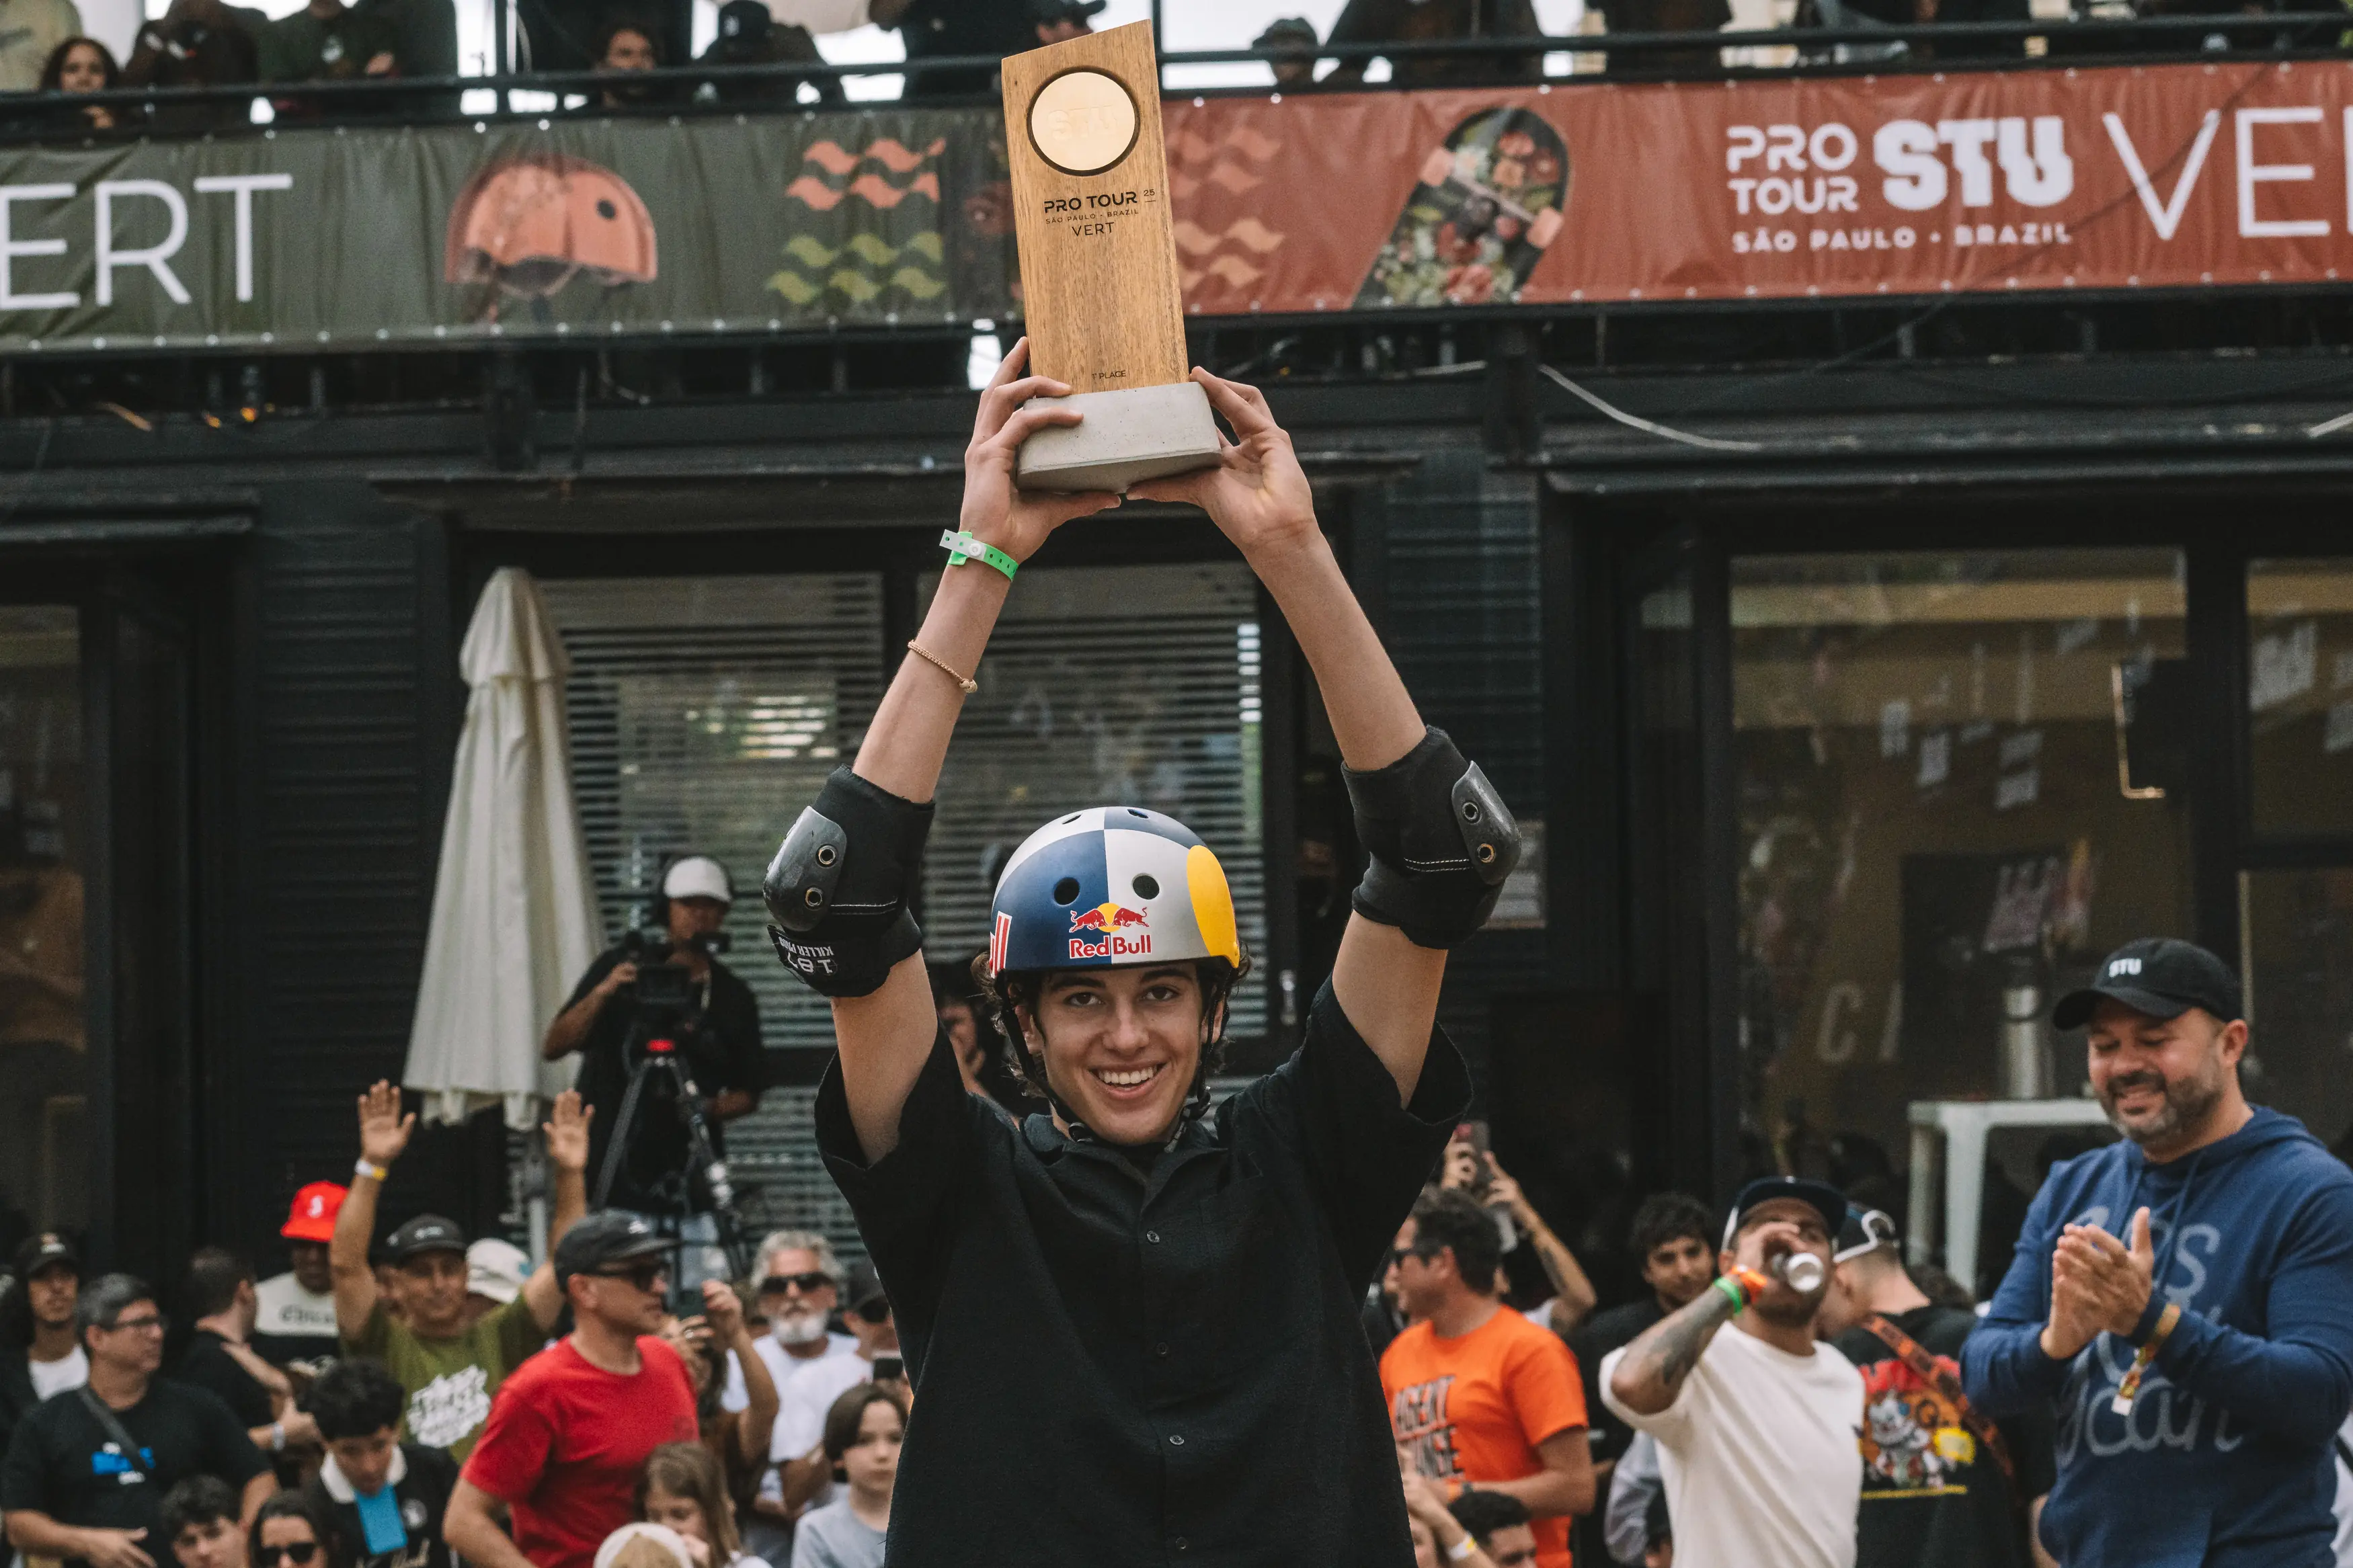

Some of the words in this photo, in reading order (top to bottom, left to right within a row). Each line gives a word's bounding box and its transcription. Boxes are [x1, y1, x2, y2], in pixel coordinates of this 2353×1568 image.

[1726, 123, 1858, 173] PRO
[1873, 116, 2075, 211] STU
[2102, 106, 2353, 241] VE
[1043, 197, 1082, 213] PRO
[1086, 191, 1138, 208] TOUR
[1143, 189, 1155, 197] 25
[1726, 175, 1860, 214] TOUR
[1045, 216, 1063, 224] SÃO
[1067, 213, 1096, 222] PAULO
[1107, 209, 1139, 217] BRAZIL
[1072, 222, 1114, 237] VERT
[1732, 226, 1797, 253] SÃO
[1810, 226, 1916, 252] PAULO
[1954, 222, 2073, 247] BRAZIL
[1099, 370, 1126, 380] PLACE
[797, 945, 834, 957] KILLER
[1070, 936, 1110, 958] Red
[1113, 934, 1152, 955] Bull
